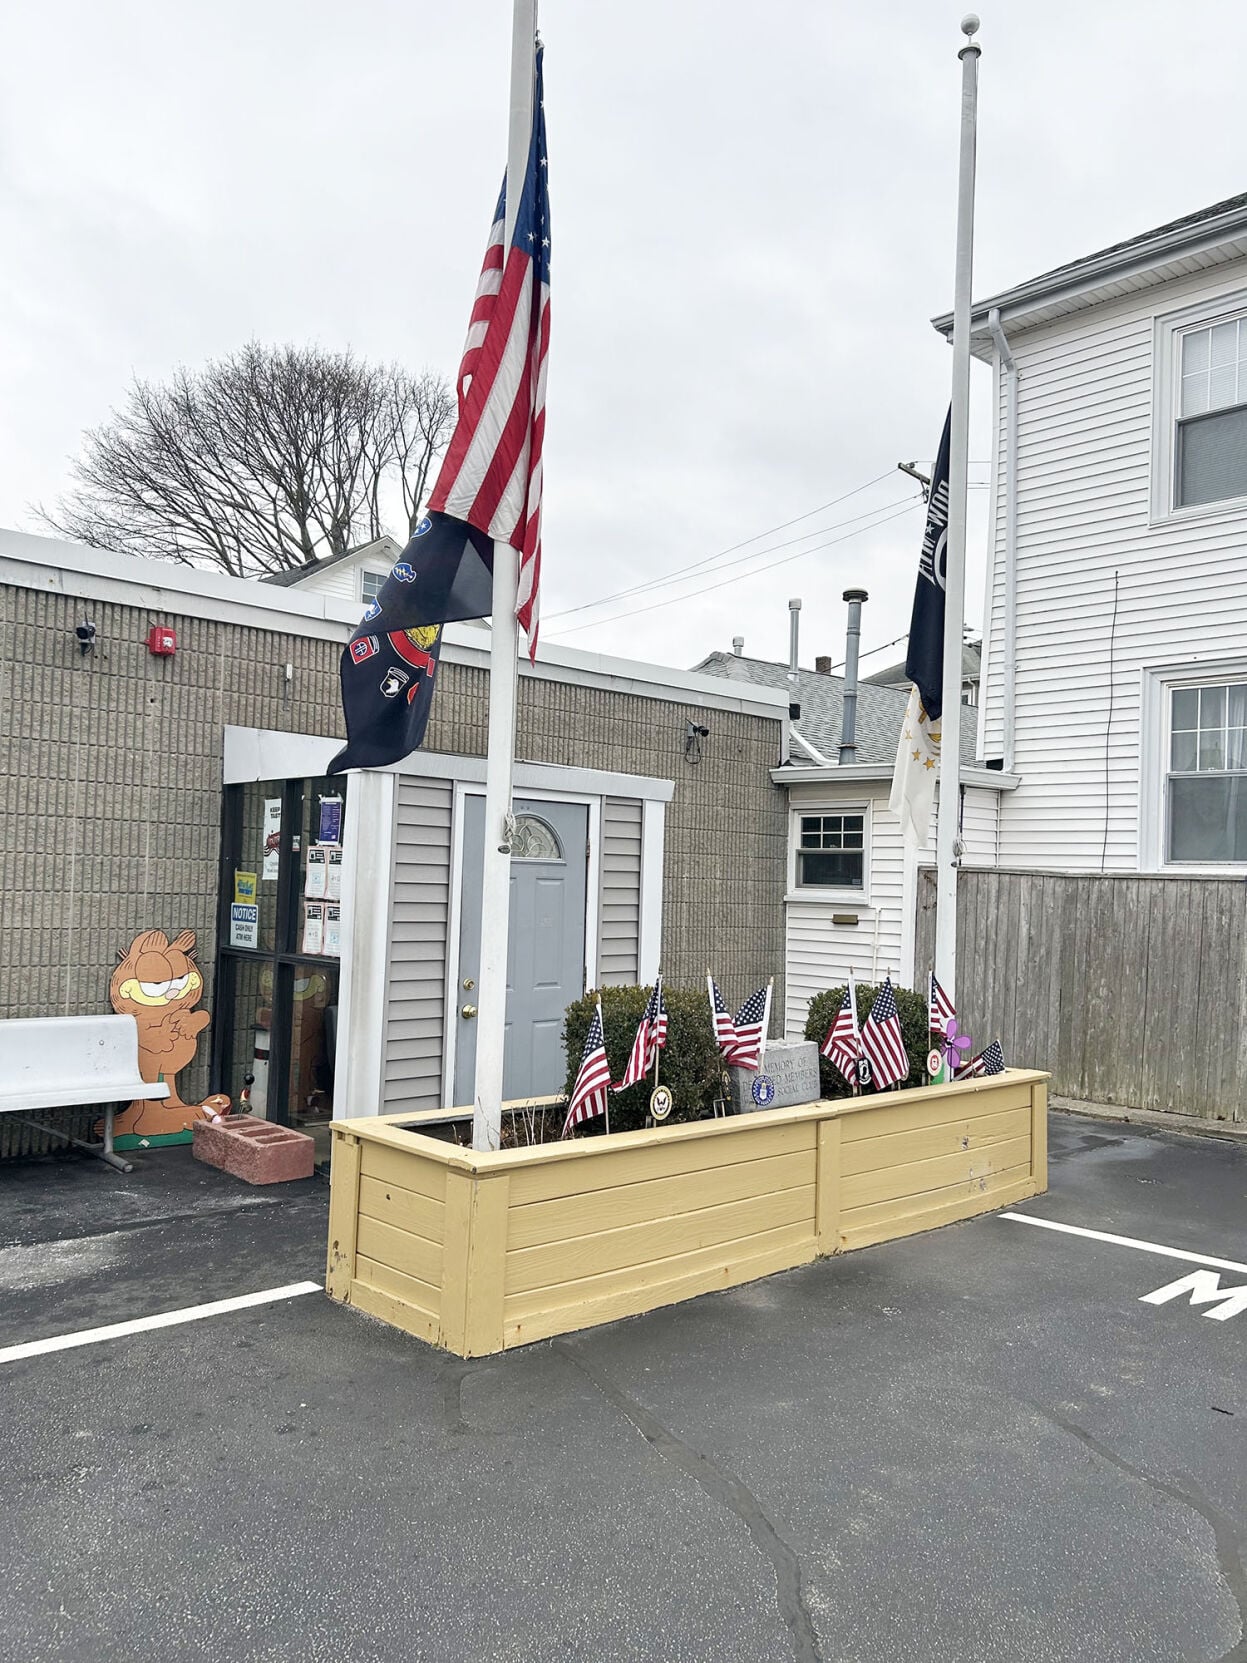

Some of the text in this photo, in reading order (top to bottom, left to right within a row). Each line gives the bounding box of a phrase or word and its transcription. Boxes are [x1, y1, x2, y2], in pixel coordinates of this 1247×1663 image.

[233, 907, 257, 921] NOTICE
[235, 924, 244, 932] CASH
[243, 933, 253, 942] HERE
[764, 1057, 807, 1073] MEMORY OF
[784, 1069, 817, 1082] MEMBERS
[777, 1083, 799, 1096] SOCIAL
[1138, 1269, 1247, 1321] M
